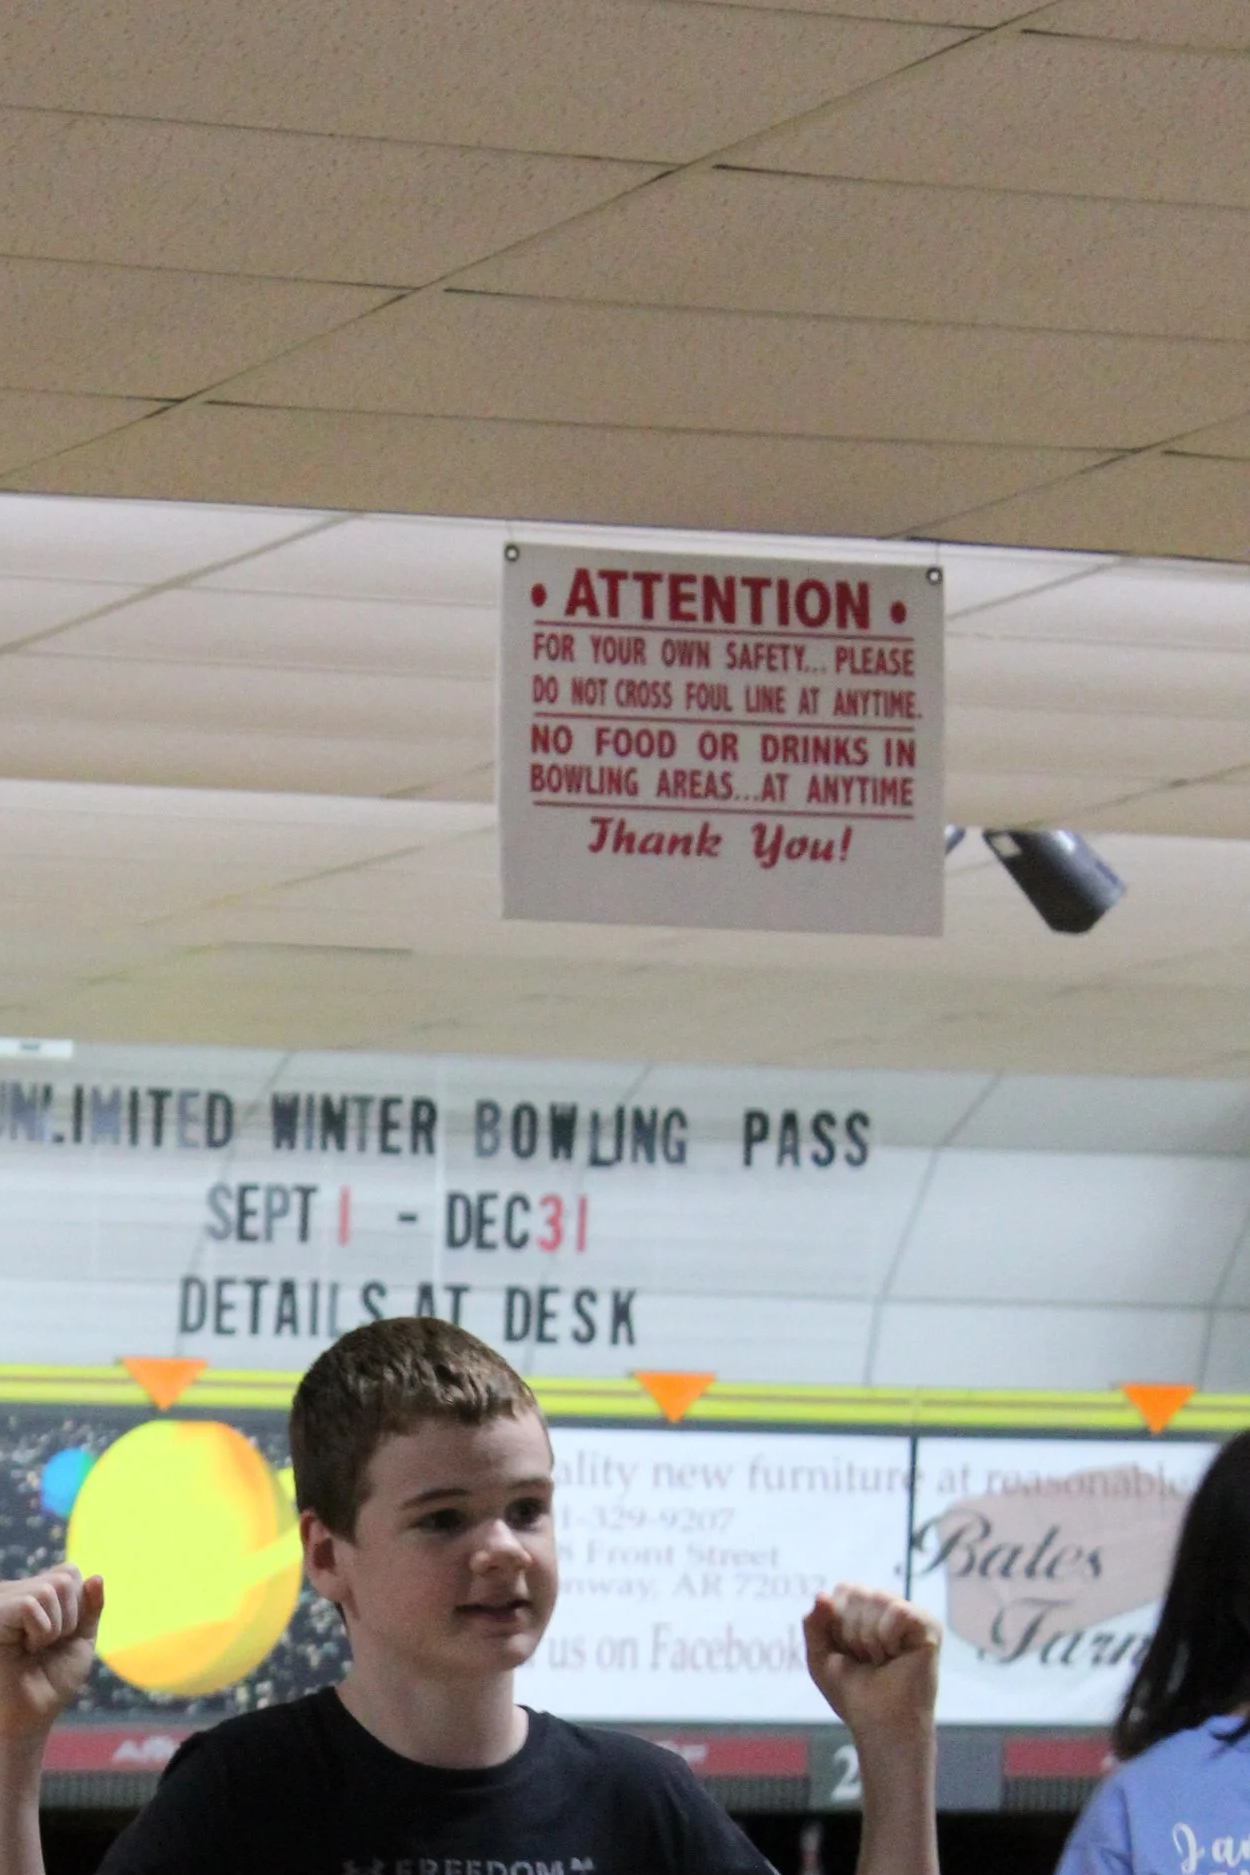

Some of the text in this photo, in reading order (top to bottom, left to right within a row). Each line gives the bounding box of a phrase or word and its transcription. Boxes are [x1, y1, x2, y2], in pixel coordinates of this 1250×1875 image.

[564, 568, 870, 629] ATTENTION
[533, 633, 574, 662] FOR
[591, 635, 646, 665] YOUR
[661, 639, 710, 669] OWN
[835, 647, 914, 677] PLEASE
[532, 675, 558, 705] DO
[572, 677, 607, 706] NOT
[615, 678, 672, 709] CROSS
[686, 682, 733, 711] FOUL
[745, 685, 785, 714] LINE
[798, 687, 820, 716] AT
[531, 725, 915, 767] NO FOOD OR DRINKS IN
[530, 764, 638, 796] BOWLING
[807, 774, 913, 806] ANYTIME
[589, 816, 853, 869] Thank You!
[271, 1092, 437, 1155] WINTER
[474, 1099, 688, 1166] BOWLING
[744, 1108, 870, 1167] PASS
[206, 1183, 317, 1243] SEPT
[504, 1285, 637, 1346] DESK
[556, 1449, 639, 1502] ality
[652, 1458, 734, 1490] new
[748, 1453, 925, 1495] furniture
[937, 1462, 971, 1494] at
[561, 1505, 735, 1533] 1-329-9207
[587, 1540, 674, 1566] Front
[686, 1540, 779, 1568] Street
[673, 1573, 722, 1598] AR
[548, 1633, 587, 1669] us
[597, 1633, 640, 1671] on
[650, 1621, 807, 1674] Facebook
[831, 1744, 863, 1801] 2
